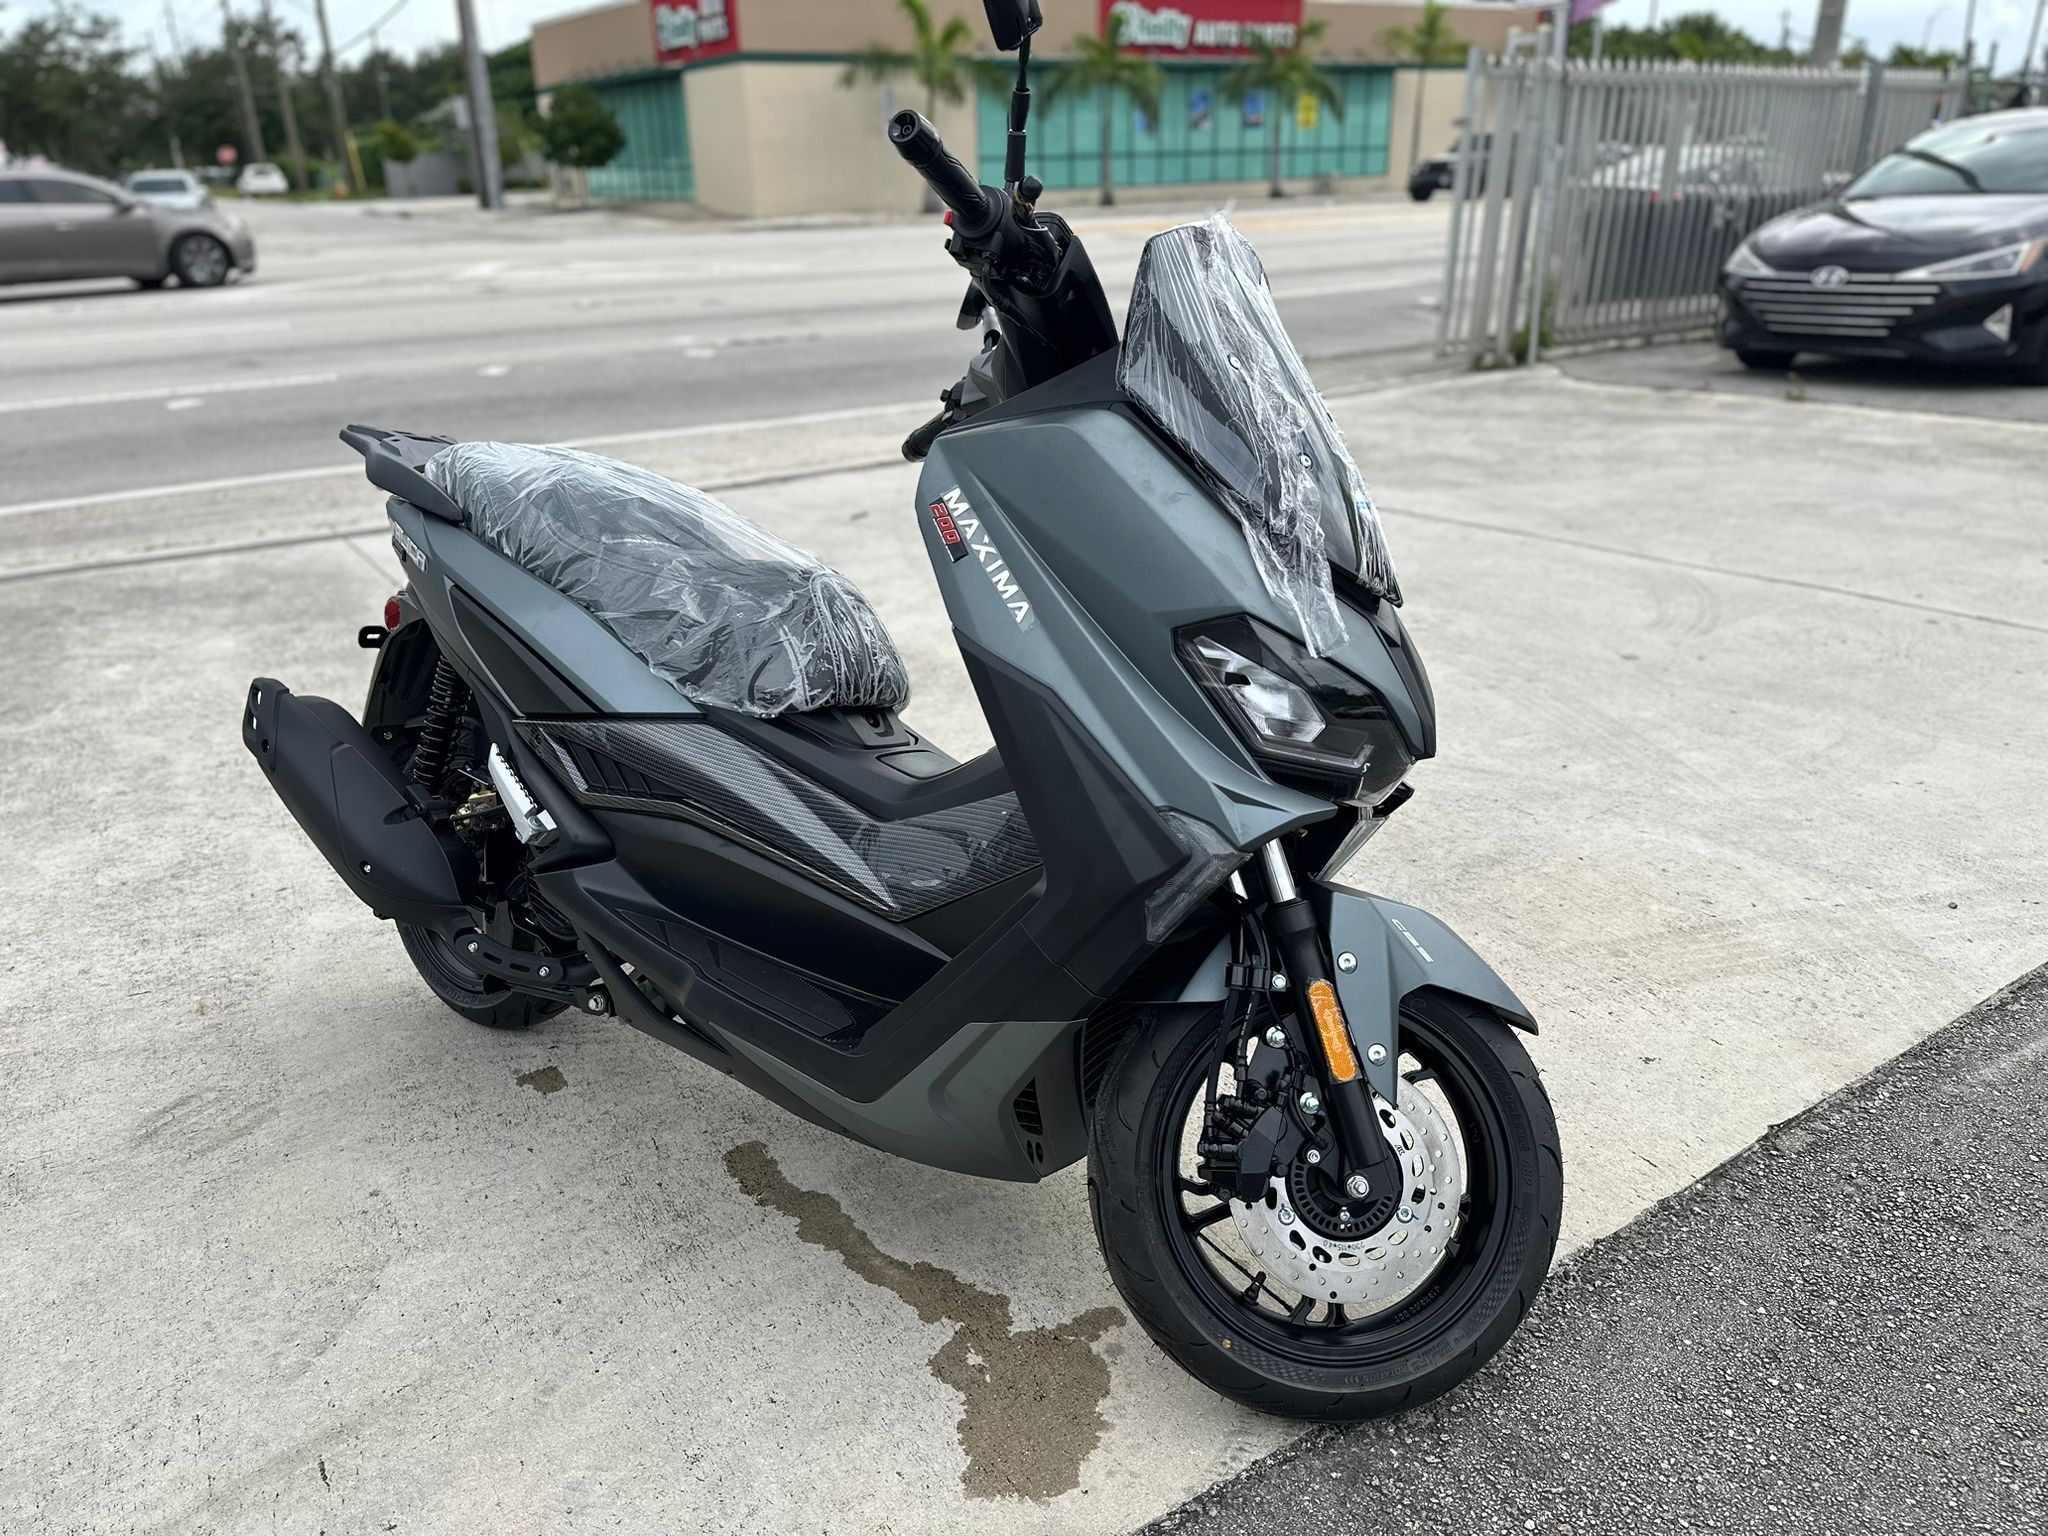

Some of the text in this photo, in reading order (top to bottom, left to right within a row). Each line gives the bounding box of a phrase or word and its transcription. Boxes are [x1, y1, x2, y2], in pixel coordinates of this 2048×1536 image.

[1194, 20, 1240, 47] AUTO
[929, 503, 961, 544] 200
[943, 487, 1030, 623] MAXIMA
[1391, 918, 1434, 963] CBS
